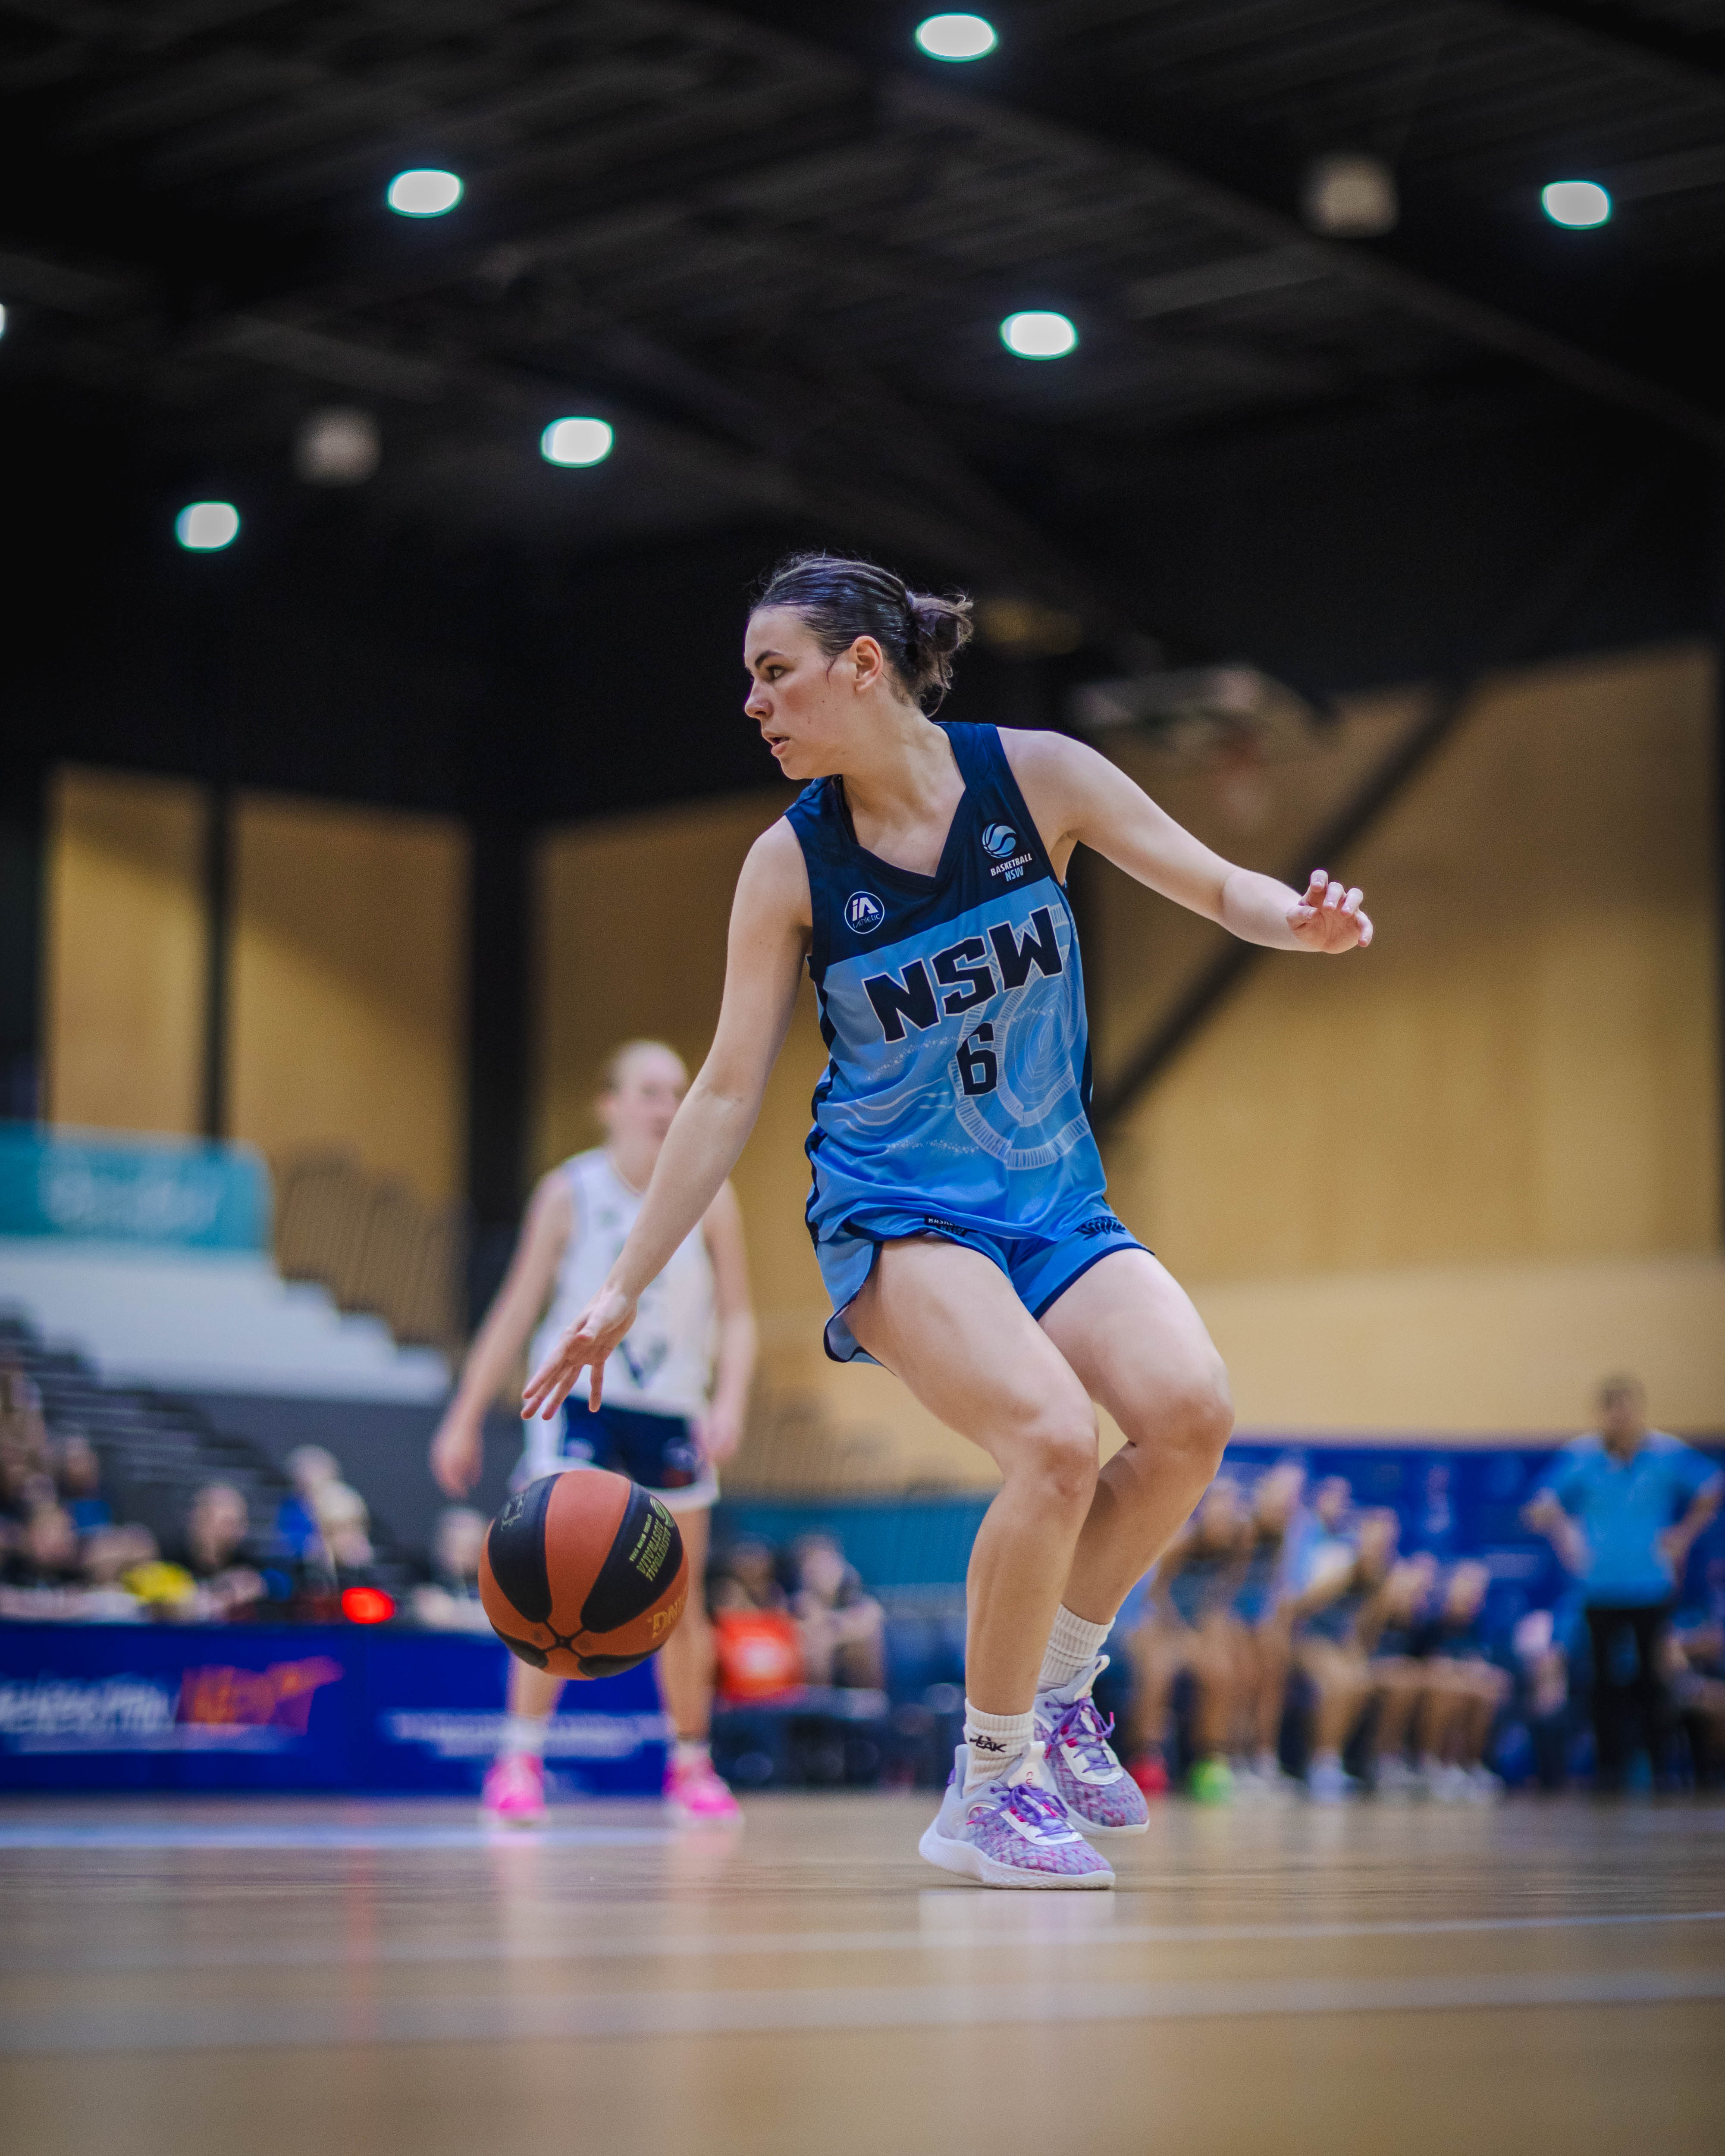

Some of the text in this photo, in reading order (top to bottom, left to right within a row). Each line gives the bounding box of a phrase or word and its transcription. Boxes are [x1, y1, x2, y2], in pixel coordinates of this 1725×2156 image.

[990, 853, 1032, 876] BASKETBALL
[1004, 866, 1024, 882] NSW
[862, 904, 1063, 1044] NSW
[956, 1022, 998, 1096] 6
[636, 1518, 664, 1574] AUSTRALIA
